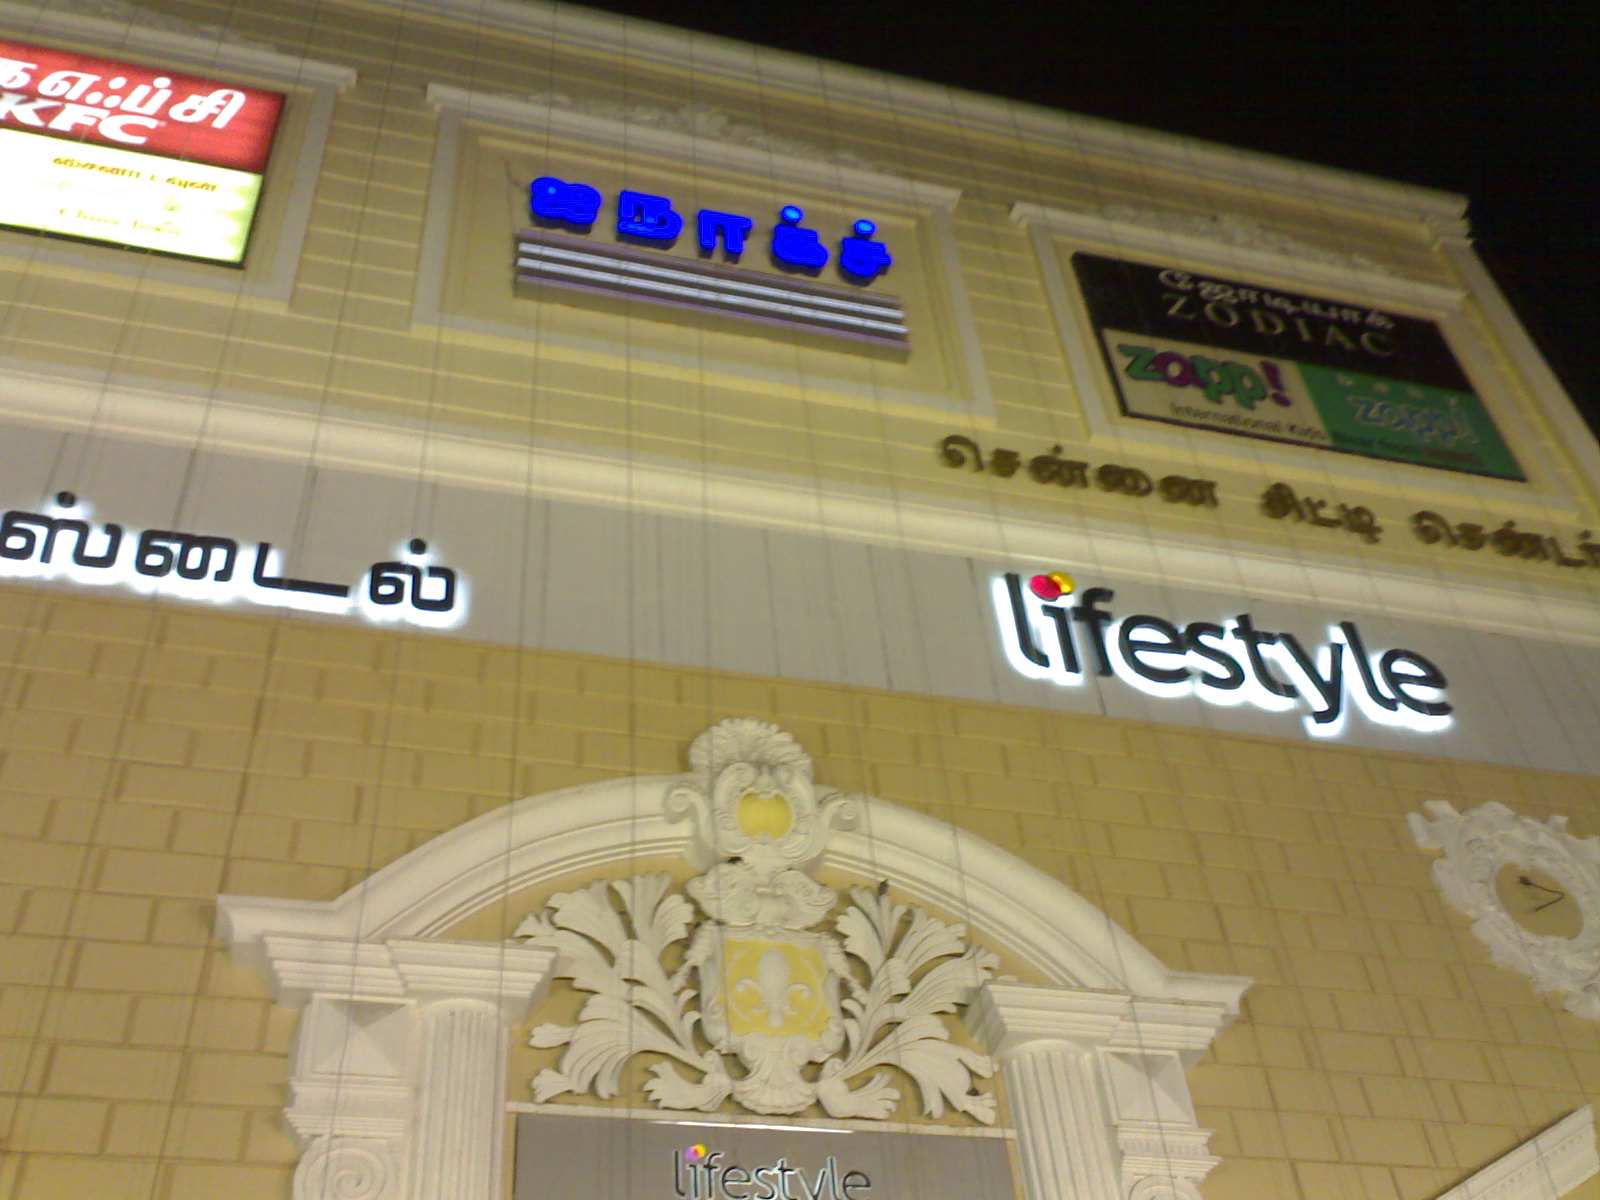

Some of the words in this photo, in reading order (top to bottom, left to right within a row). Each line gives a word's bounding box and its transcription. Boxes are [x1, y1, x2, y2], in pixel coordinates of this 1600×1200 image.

[0, 92, 160, 145] KFC
[1161, 293, 1396, 359] ZODIAC
[940, 434, 1218, 508] சென்னை
[1004, 571, 1453, 726] lifestyle
[672, 1144, 872, 1200] lifestyle
